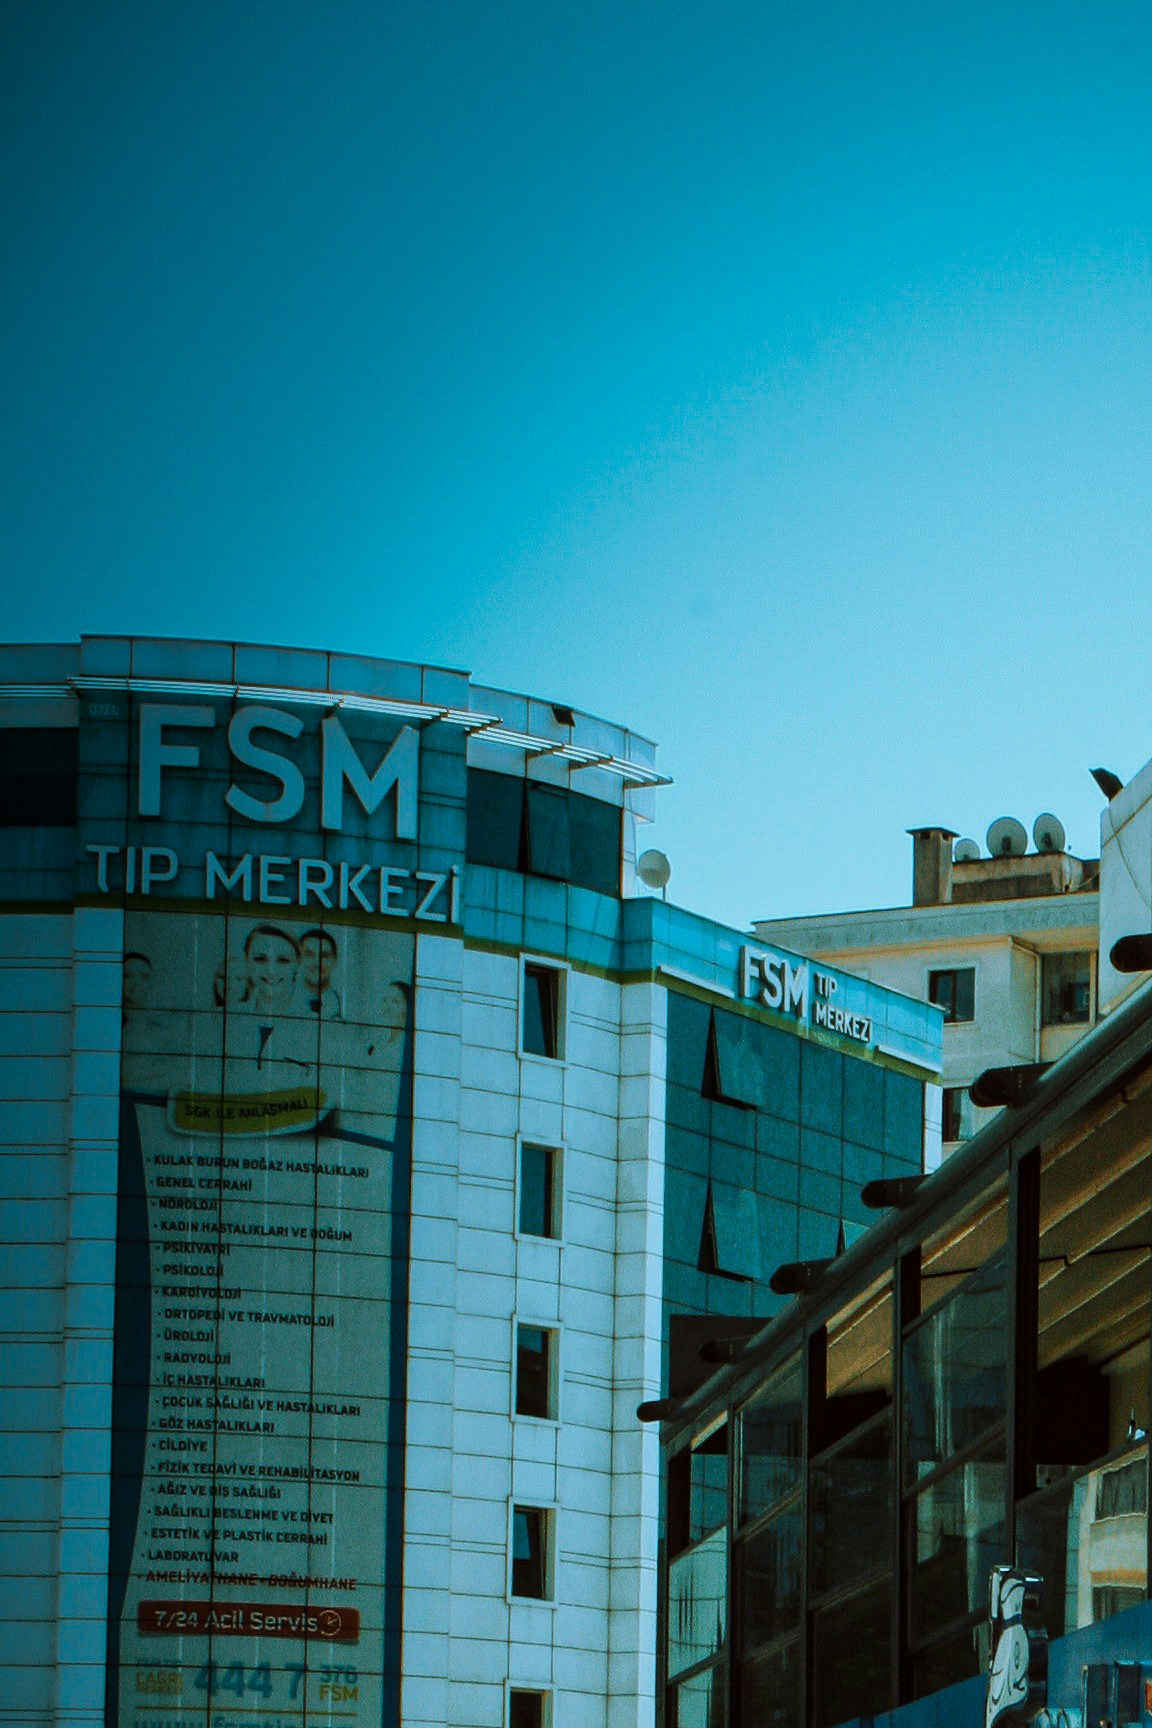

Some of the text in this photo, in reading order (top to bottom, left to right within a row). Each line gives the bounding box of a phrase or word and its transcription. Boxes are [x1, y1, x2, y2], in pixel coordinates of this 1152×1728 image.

[138, 703, 420, 840] FSM
[86, 844, 461, 924] TIP MERKEZİ
[741, 945, 809, 1018] FSM
[815, 972, 838, 998] TIP
[815, 1001, 873, 1043] MERKEZİ
[185, 1103, 211, 1118] SGK
[239, 1098, 308, 1118] ANLAŞMALI
[154, 1154, 370, 1179] KULAK BURUN BOĞAZ HASTALIKLARI
[156, 1176, 253, 1192] GENEL CERRAHİ
[159, 1197, 218, 1212] NÖROLOJİ
[161, 1220, 353, 1242] KADIN HASTALIKLARI VE DOĞUM
[163, 1264, 224, 1277] PSİKOLOJİ
[162, 1286, 241, 1299] KARDİYOLOJİ
[164, 1308, 335, 1327] ORTOPEDİ VE TRAVMATOLOJİ
[164, 1327, 214, 1342] ÜROLOJİ
[164, 1352, 231, 1365] RADYOLOJİ
[163, 1374, 265, 1388] İÇ HASTALIKLARI
[161, 1396, 361, 1417] ÇOCUK SAĞLIĞI VE HASTALIKLARI
[159, 1416, 275, 1433] GÖZ HASTALIKLARI
[159, 1437, 208, 1451] CİLDİYE
[158, 1460, 360, 1482] FİZİK TEDAVİ VE REHABİLİTASYON
[157, 1481, 188, 1496] AĞIZ
[190, 1485, 206, 1496] VE
[232, 1485, 281, 1499] SAĞLIĞI
[154, 1503, 210, 1518] SAĞLIKLI
[213, 1508, 278, 1521] BESLENME
[282, 1510, 297, 1522] VE
[151, 1526, 328, 1545] ESTETİK VE PLASTİK CERRAHİ
[148, 1550, 239, 1563] LABORATUVAR
[154, 1610, 318, 1633] 7/24 Acil Servis
[194, 1661, 272, 1699] 444
[284, 1662, 306, 1700] 7
[320, 1685, 359, 1701] FSM
